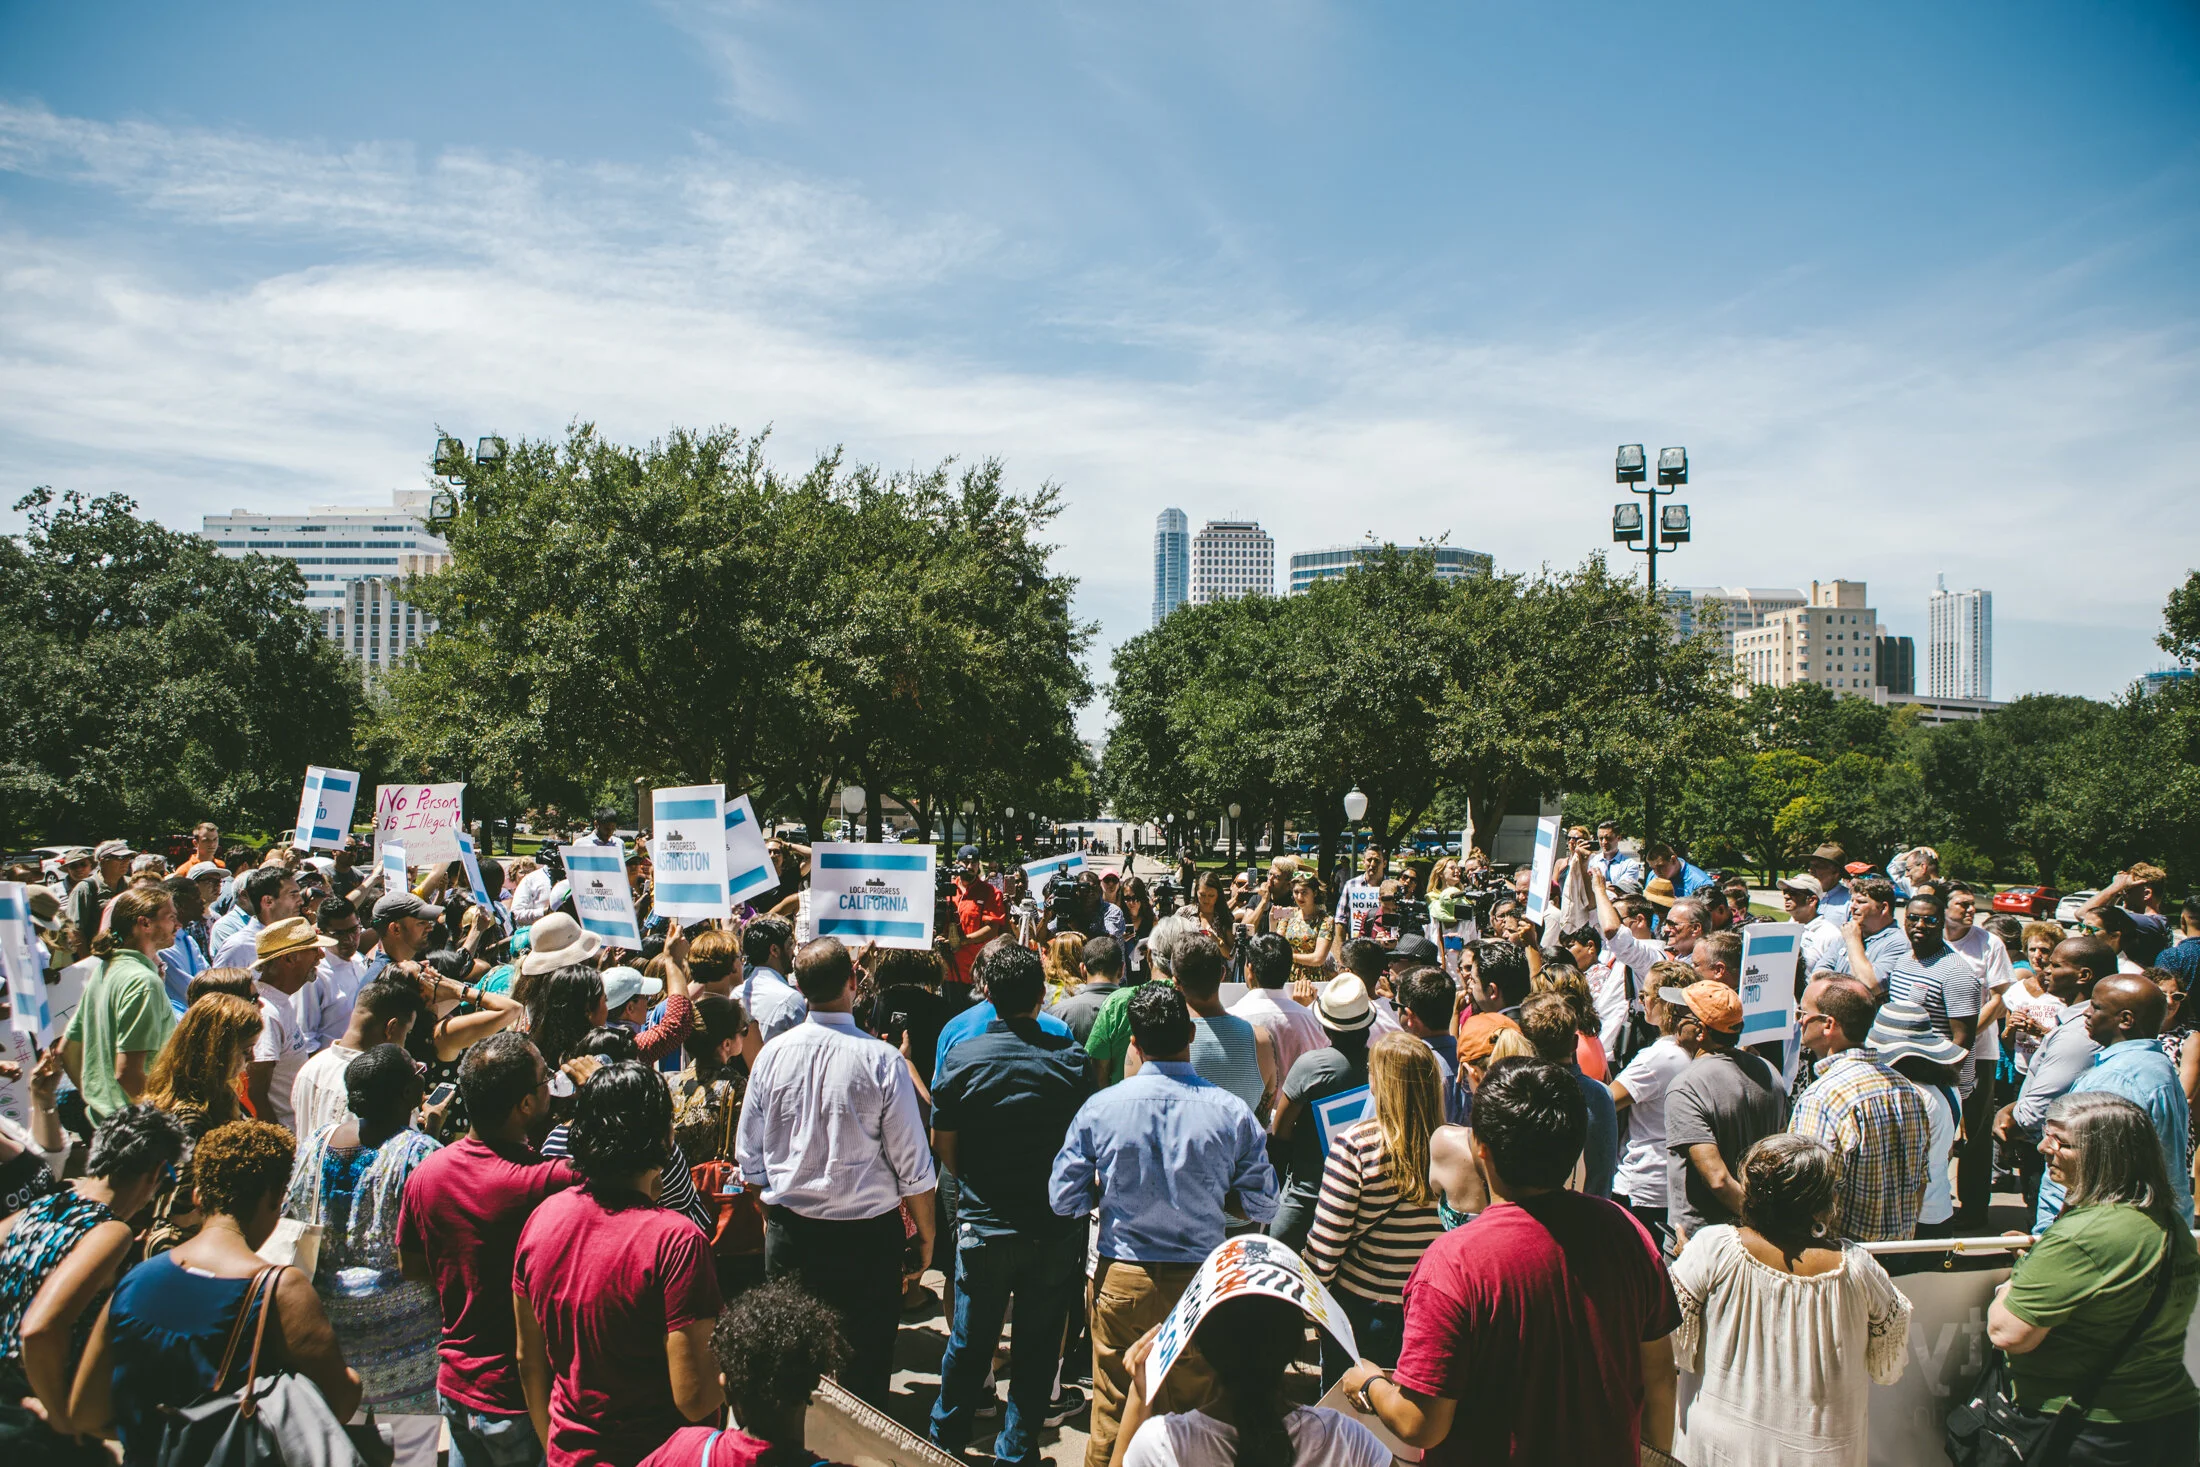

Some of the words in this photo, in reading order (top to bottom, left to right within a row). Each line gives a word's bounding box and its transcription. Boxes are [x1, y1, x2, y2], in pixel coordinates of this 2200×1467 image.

[379, 786, 407, 813] No
[416, 787, 459, 810] Person
[384, 815, 399, 831] is
[669, 841, 697, 851] PROGRESS
[849, 886, 868, 894] LOCAL
[869, 886, 900, 895] PROGRESS
[1352, 892, 1366, 900] NO
[839, 894, 909, 912] CALIFORNIA
[1747, 973, 1769, 984] PROGRESS
[1183, 1300, 1201, 1338] NO
[1160, 1329, 1179, 1377] NO
